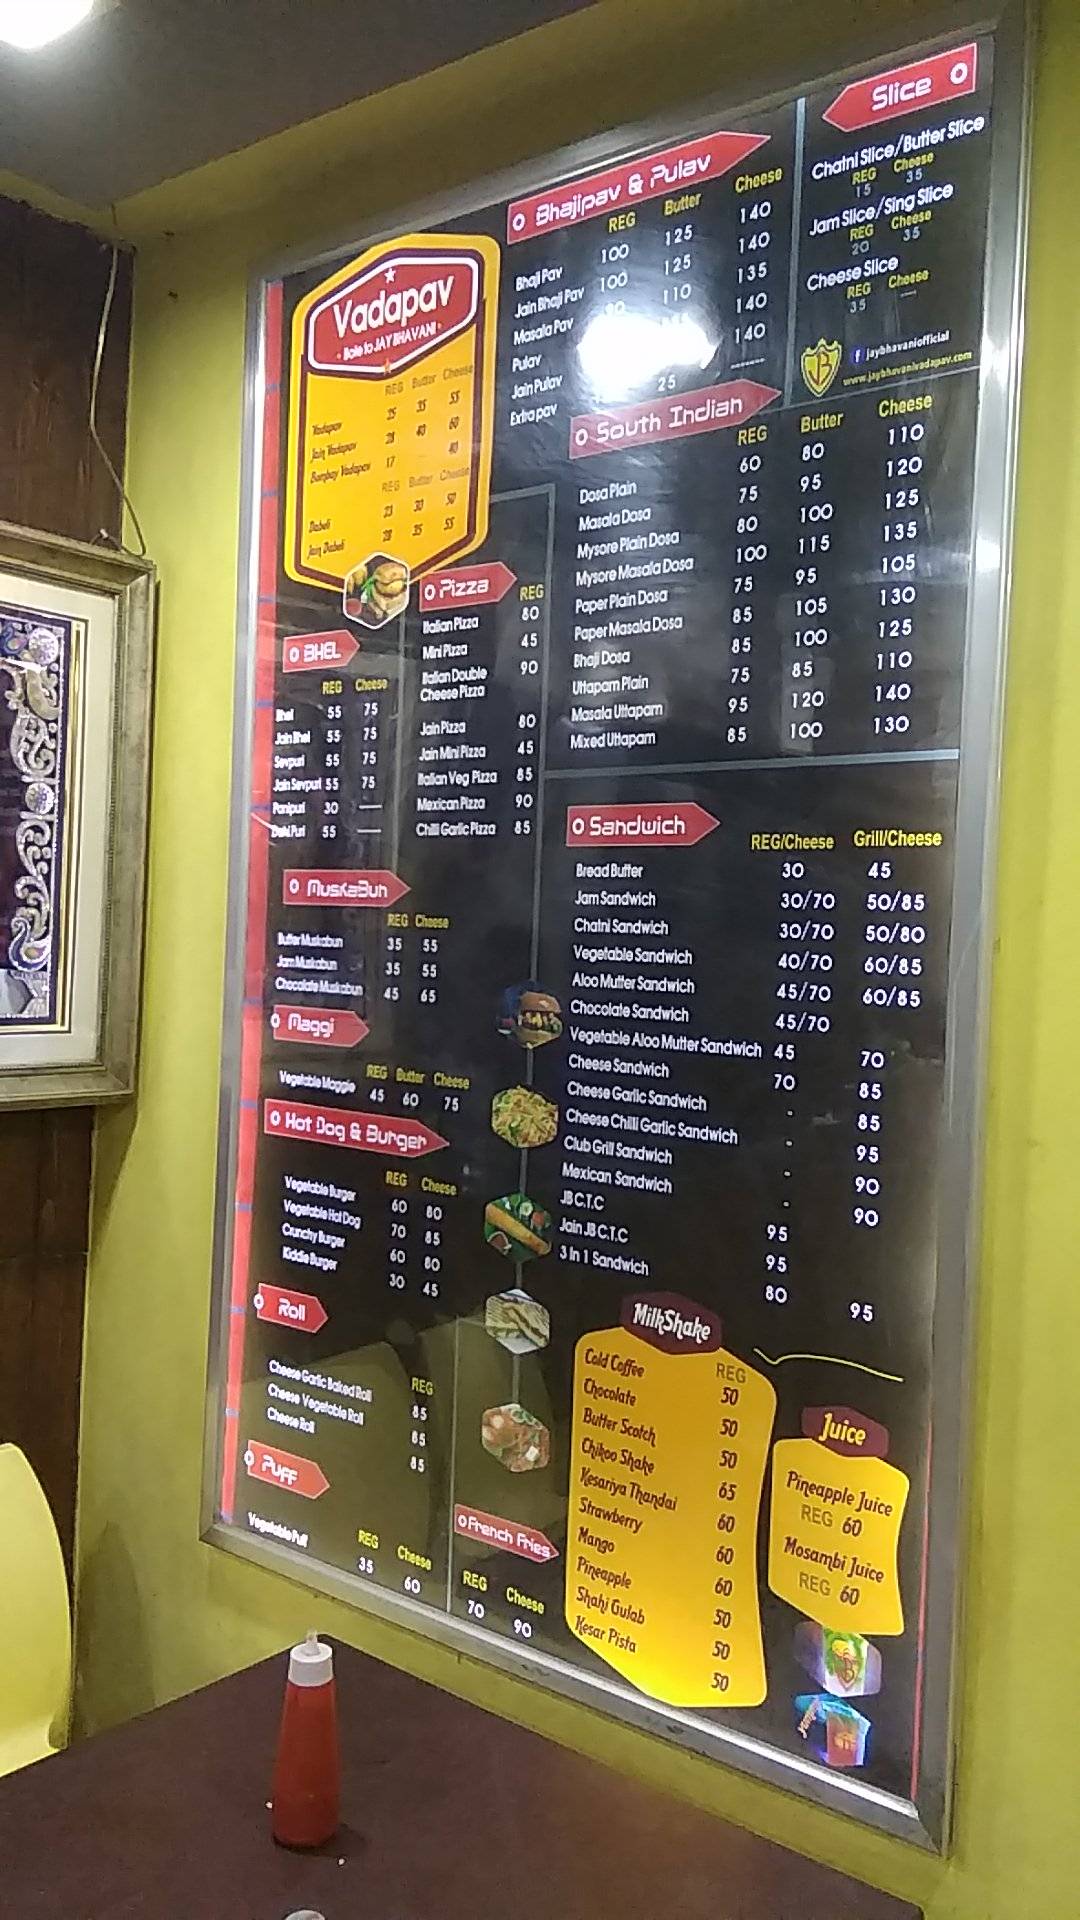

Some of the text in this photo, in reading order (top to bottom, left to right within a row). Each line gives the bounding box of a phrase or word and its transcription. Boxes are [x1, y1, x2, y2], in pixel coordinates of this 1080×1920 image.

[871, 76, 932, 110] Slice
[945, 114, 985, 142] Slice
[628, 173, 644, 196] &
[650, 152, 712, 189] Pulav
[852, 152, 934, 185] REG Cheese
[608, 168, 783, 233] REG Butter Cheese
[808, 216, 842, 237] Jam
[917, 183, 953, 206] Slice
[542, 265, 562, 283] Pav
[601, 244, 629, 264] 100
[664, 226, 692, 246] 125
[739, 202, 771, 224] 140
[850, 210, 931, 242] REG Cheese
[664, 233, 770, 276] 125 140
[737, 263, 767, 283] 135
[807, 256, 898, 292] Cheese Slice
[333, 277, 454, 337] Vadapav
[512, 354, 541, 372] Pulav
[598, 396, 742, 441] South Indian
[737, 394, 933, 445] REG Butter Cheese
[580, 424, 924, 504] Dosa Plain 60 80 110
[579, 457, 922, 531] Masala Dosa 75 95 120
[737, 489, 919, 533] 80 100 125
[440, 578, 488, 599] Pizza
[520, 585, 544, 600] REG
[454, 606, 539, 630] Pizza 80
[520, 661, 538, 675] 90
[323, 678, 387, 694] REG Cheese
[327, 703, 378, 718] 55 75
[570, 733, 606, 749] Mixed
[727, 728, 746, 742] 85
[790, 723, 823, 739] 100
[873, 716, 909, 734] 130
[417, 794, 533, 811] Mexican Pizza 90
[589, 816, 684, 836] Sandwich
[751, 829, 942, 851] REG/Cheese Grill/Cheese
[576, 862, 891, 878] Bread Butter 30 45
[575, 890, 925, 912] Jam Sandwich 30/70 50/85
[388, 913, 449, 929] REG Cheese
[387, 938, 437, 952] 35 55
[288, 1015, 335, 1035] Maggi
[570, 1026, 630, 1046] Vegetable
[631, 1032, 659, 1049] Aloo
[701, 1038, 762, 1059] Sandwich
[774, 1045, 795, 1060] 45
[860, 1051, 884, 1067] 70
[367, 1064, 470, 1089] REG Cheese
[369, 1089, 459, 1111] 45 60 75
[285, 1111, 312, 1131] Hot
[350, 1124, 361, 1139] &
[366, 1125, 426, 1151] Burger
[386, 1171, 456, 1195] REG Cheese
[562, 1164, 672, 1193] Mexican Sandwich
[391, 1200, 442, 1220] 60 80
[559, 1246, 568, 1261] 3
[592, 1252, 648, 1275] Sandwich
[849, 1304, 873, 1321] 95
[279, 1298, 305, 1321] Roll
[633, 1302, 711, 1342] MilkShake
[584, 1348, 738, 1406] Cold Coffee 50
[716, 1363, 746, 1383] REG
[583, 1378, 738, 1437] Chocolate 50
[583, 1408, 657, 1446] Butter Scotch
[818, 1413, 866, 1446] Juice
[620, 1448, 655, 1475] Shake
[718, 1482, 736, 1501] 65
[630, 1483, 677, 1512] Thandai
[786, 1471, 893, 1518] Pineapple Juice
[468, 1516, 550, 1558] French Fries
[579, 1497, 734, 1565] Strawberry 60
[800, 1504, 861, 1537] REG 60
[359, 1530, 431, 1571] REG Cheese
[577, 1527, 615, 1554] Mango
[359, 1557, 420, 1594] 35 60
[576, 1557, 632, 1589] Pineapple
[783, 1536, 885, 1586] Mosambi Juice
[463, 1570, 544, 1615] REG Cheese
[576, 1587, 645, 1625] Shahi Gulab
[467, 1600, 532, 1638] 70 90
[575, 1616, 729, 1692] Kesar Pista 50
